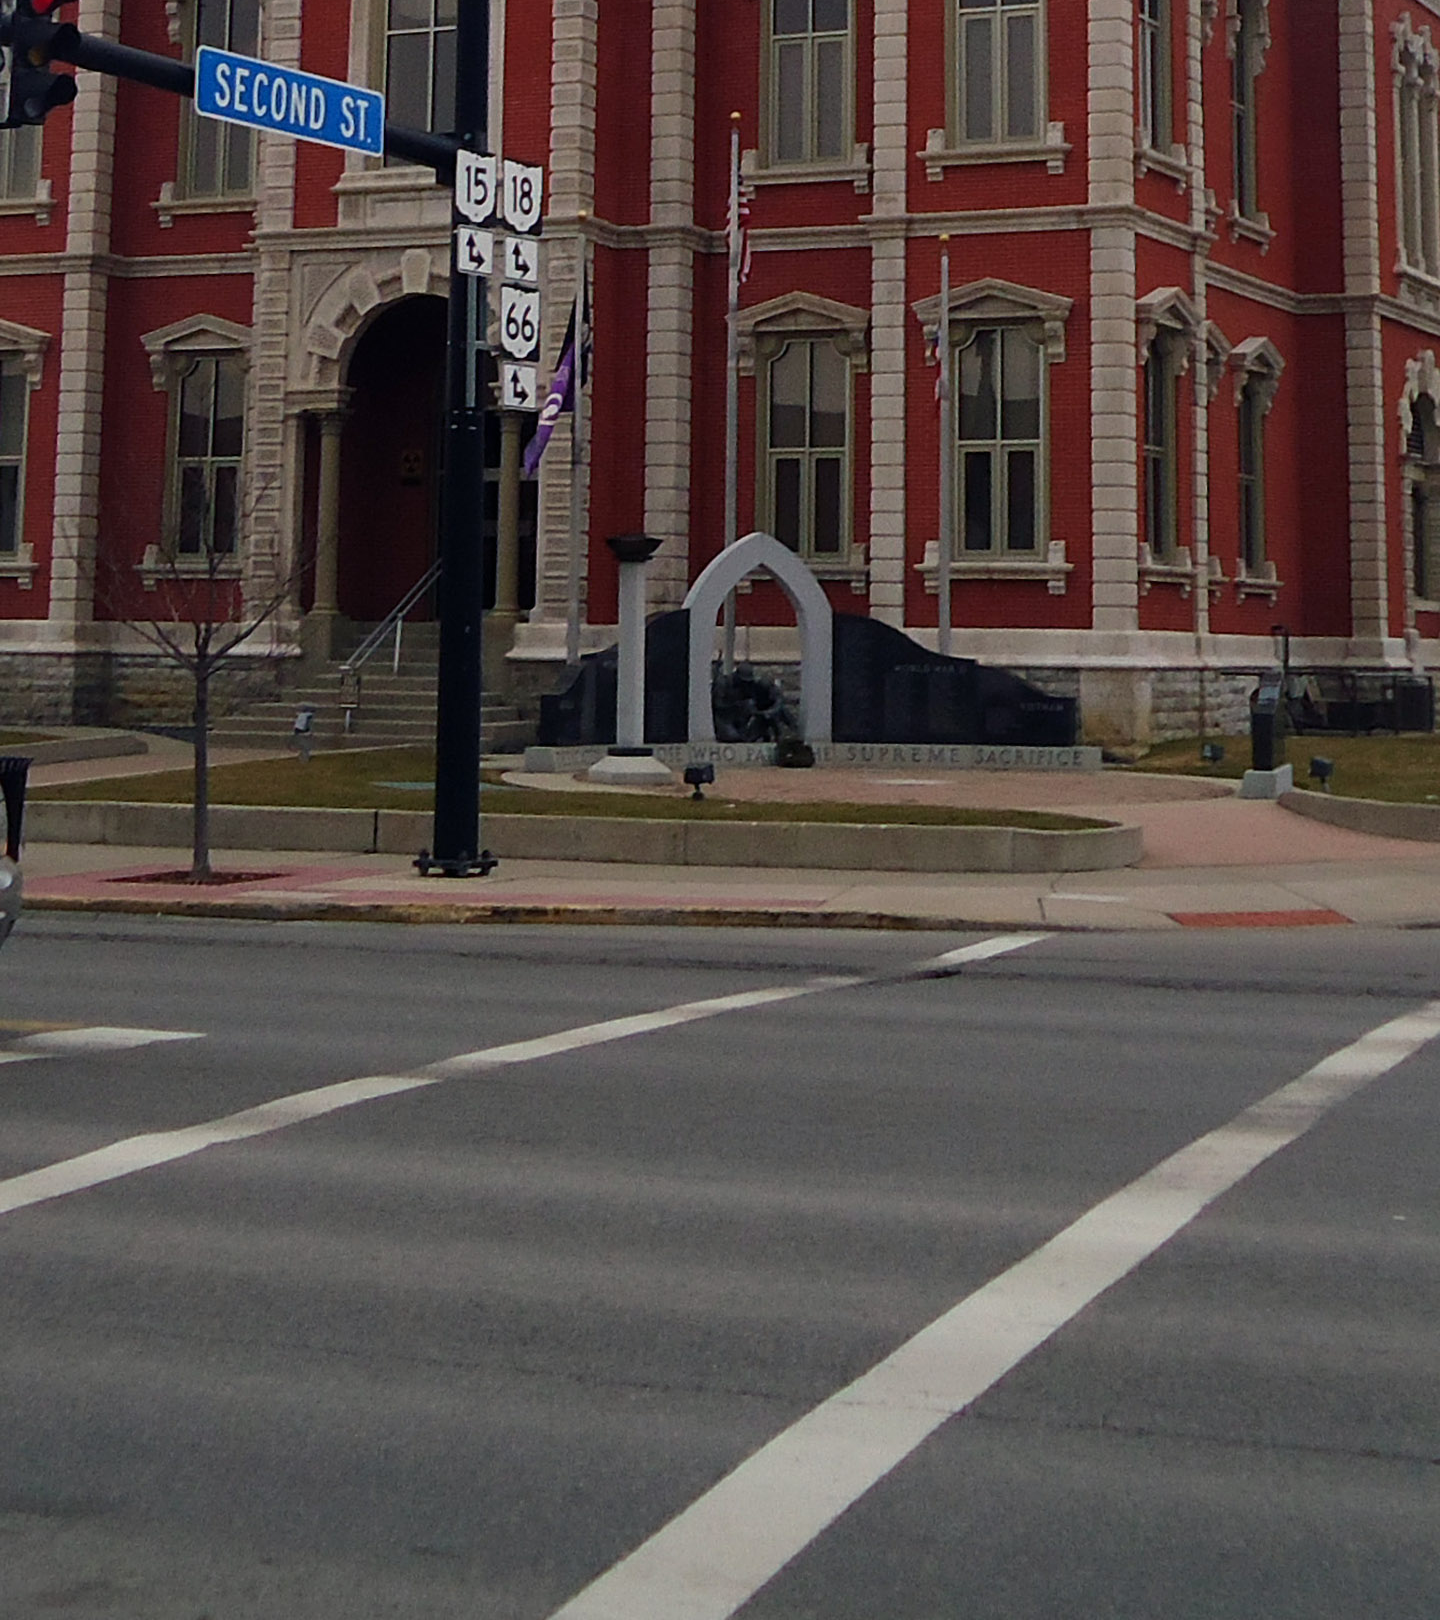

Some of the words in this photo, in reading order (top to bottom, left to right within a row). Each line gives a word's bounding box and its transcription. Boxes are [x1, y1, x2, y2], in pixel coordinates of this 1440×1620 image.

[214, 62, 326, 130] SECOND
[340, 95, 372, 144] ST.
[465, 165, 489, 206] 15
[511, 175, 534, 216] 18
[505, 301, 535, 343] 66
[692, 746, 737, 763] WHO
[846, 746, 961, 764] SUPREME
[974, 748, 1083, 767] SACRIFICE
